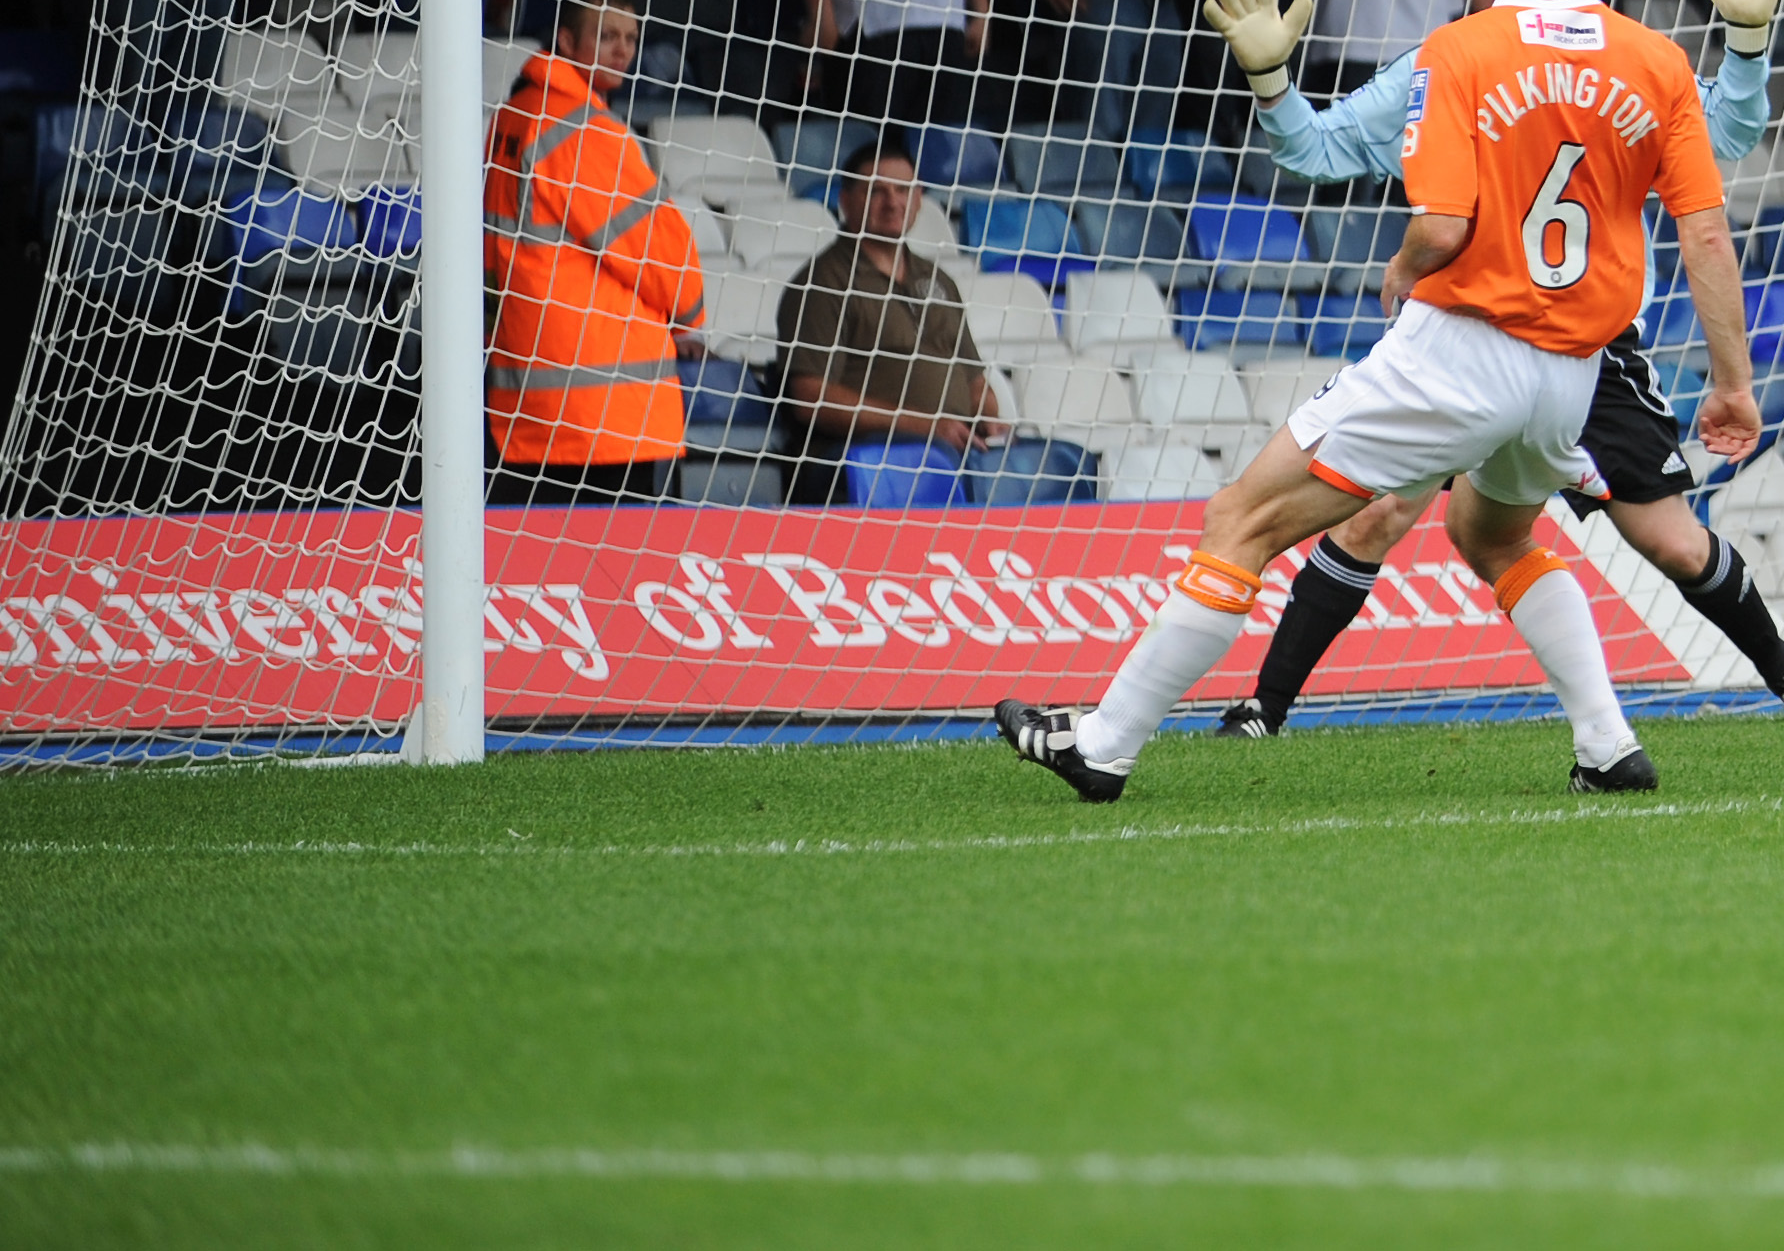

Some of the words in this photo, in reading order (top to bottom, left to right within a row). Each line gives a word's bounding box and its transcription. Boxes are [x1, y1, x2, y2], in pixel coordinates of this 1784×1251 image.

[1478, 63, 1659, 147] PILKINGTON
[1522, 141, 1590, 290] 6
[0, 557, 609, 680] niversty
[633, 552, 774, 650] of
[742, 544, 1501, 648] Bedforsir
